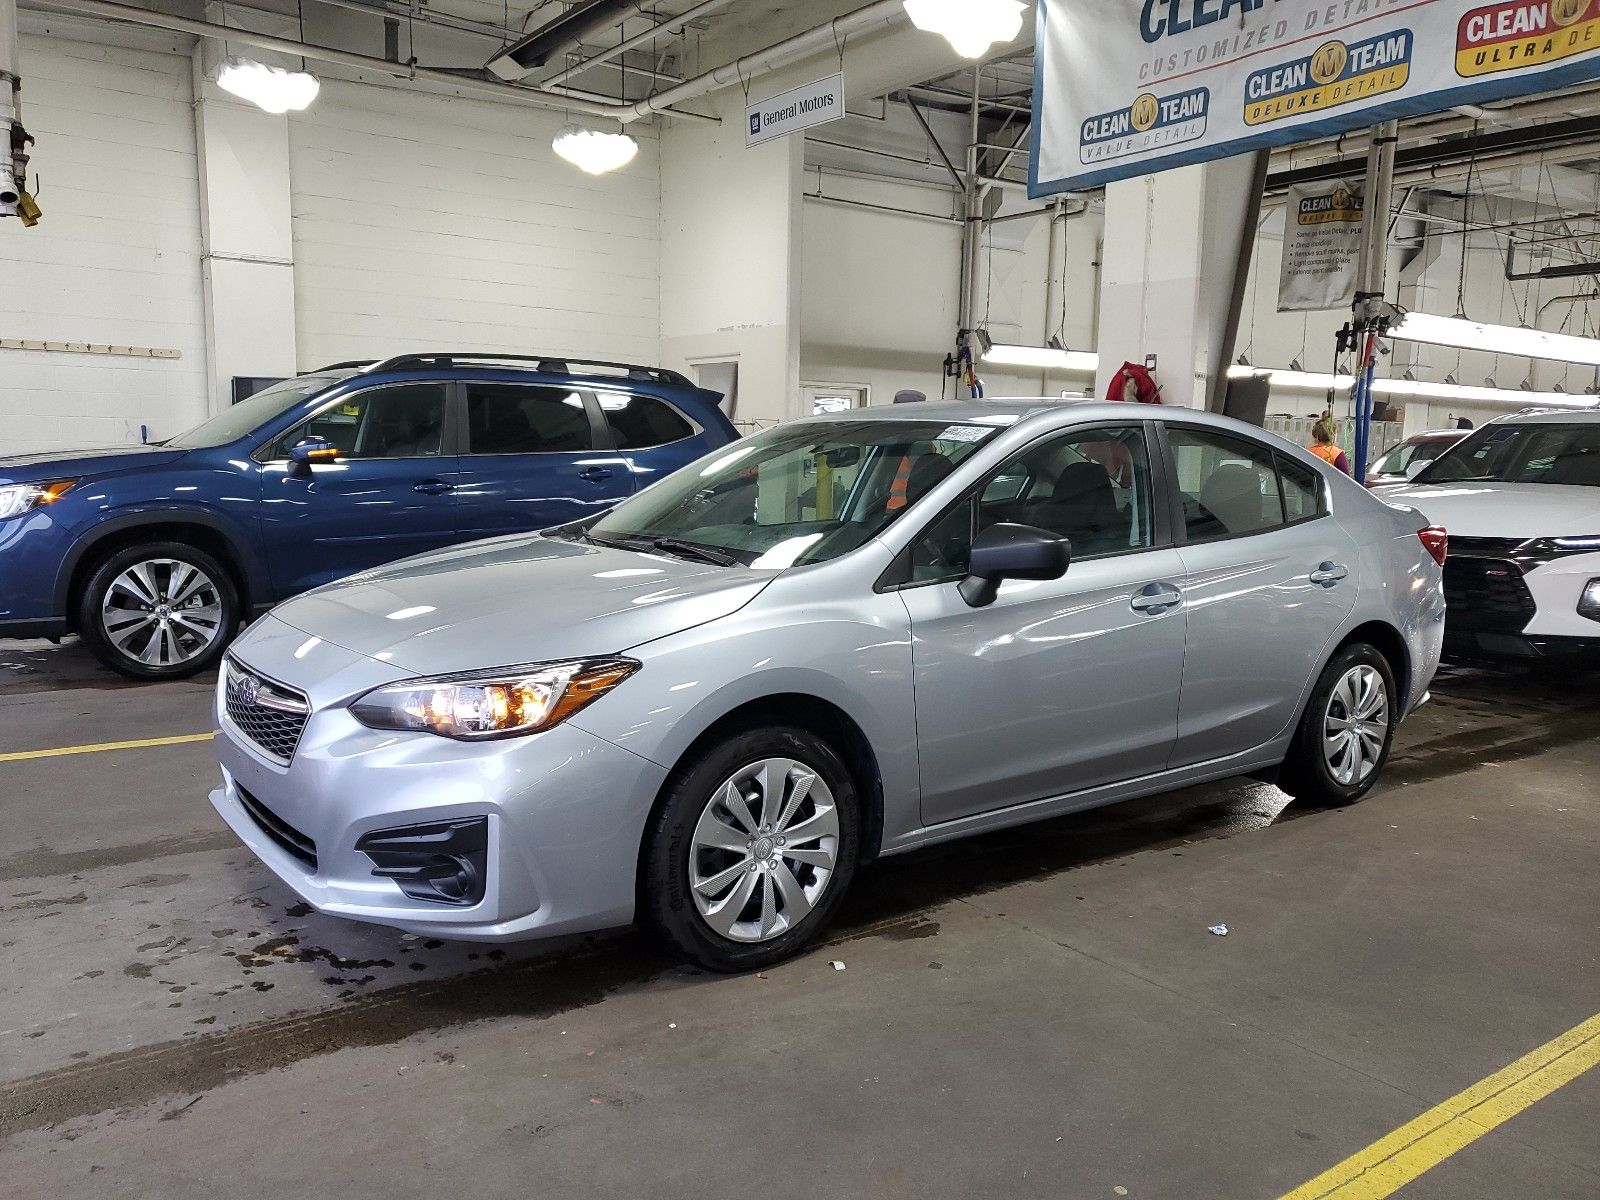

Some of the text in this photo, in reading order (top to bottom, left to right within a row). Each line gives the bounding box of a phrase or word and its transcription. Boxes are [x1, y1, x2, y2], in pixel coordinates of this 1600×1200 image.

[1466, 2, 1548, 43] CLEAN
[1139, 20, 1288, 80] CUSTOMIZED
[1249, 63, 1307, 99] CLEAN
[1350, 35, 1406, 73] TEAM
[1475, 38, 1552, 66] ULTRA
[763, 93, 834, 127] General Motors
[1252, 71, 1396, 119] DELUXE DETAIL
[1083, 112, 1130, 141] CLEAN
[1160, 92, 1205, 122] TEAM
[1087, 123, 1197, 158] VALUE DETAIL
[1301, 197, 1332, 212] CLEAN
